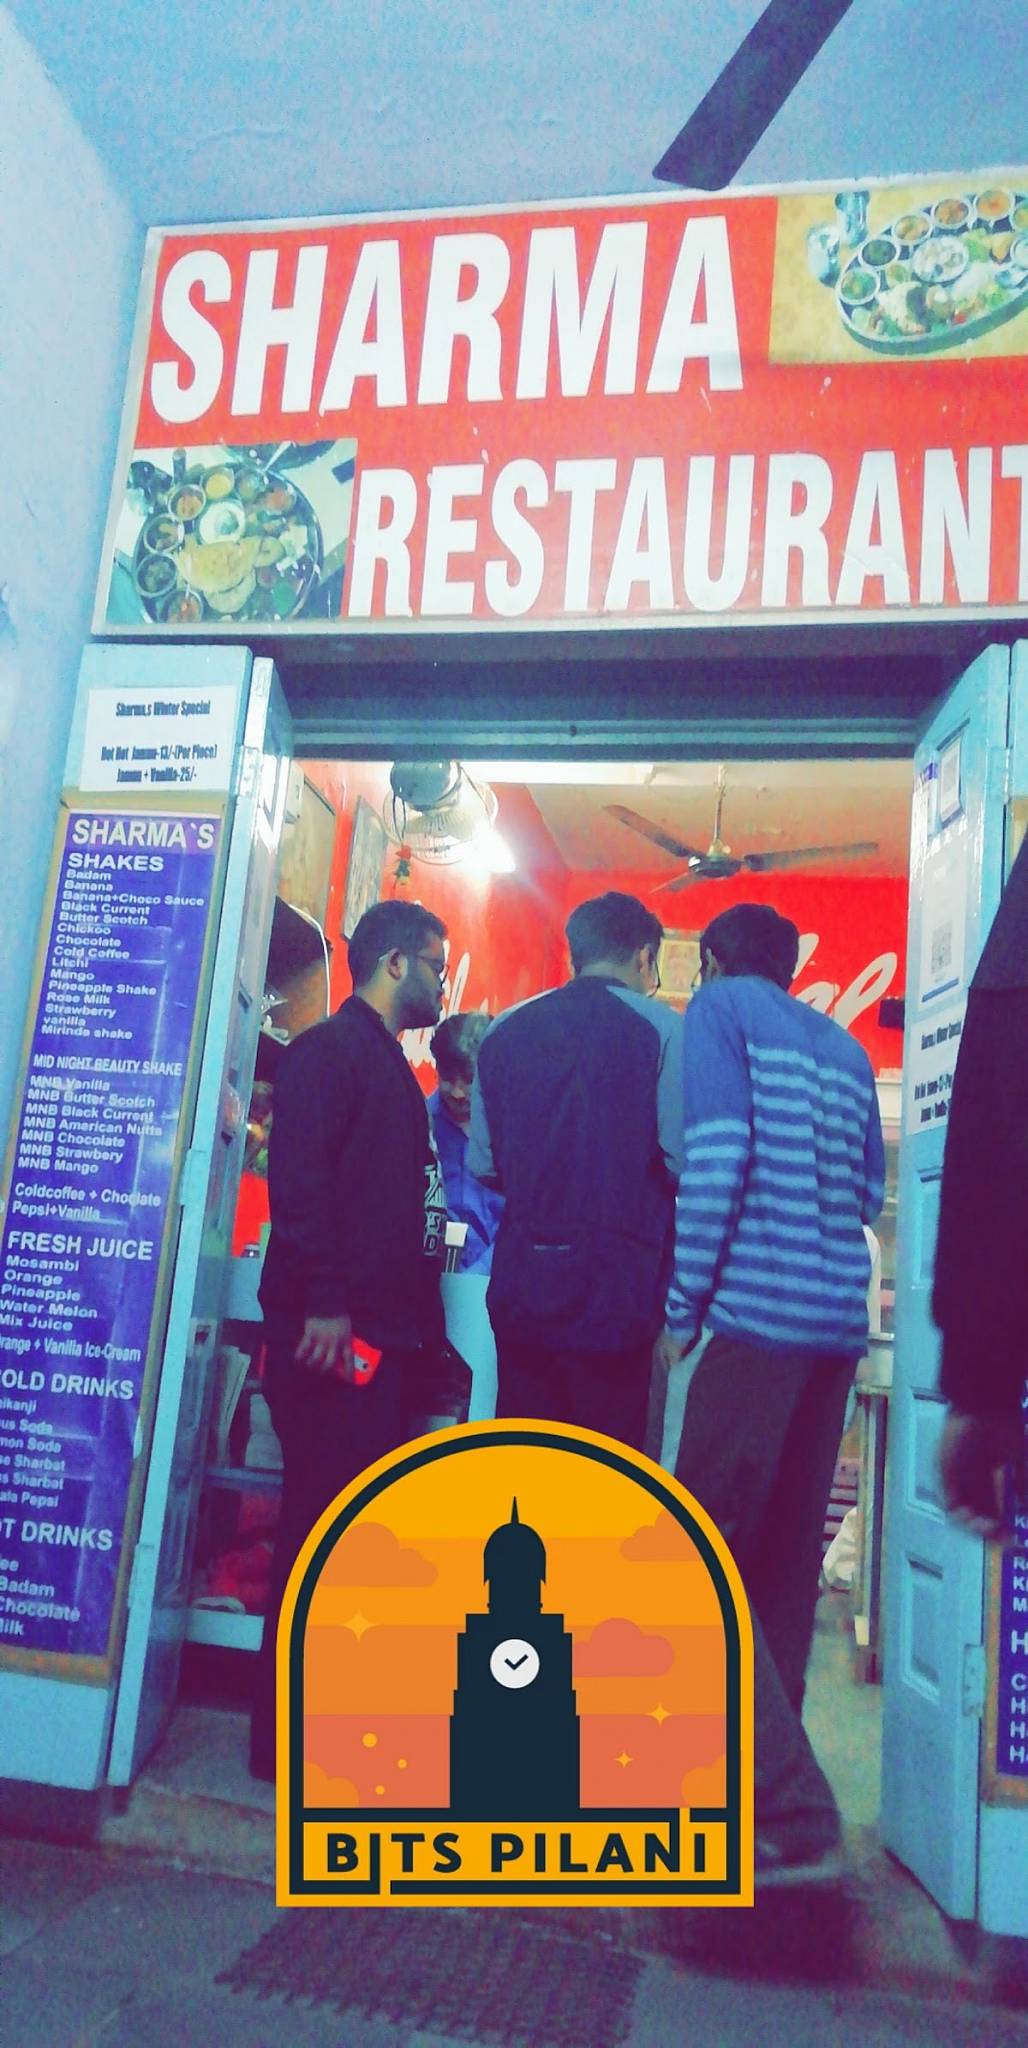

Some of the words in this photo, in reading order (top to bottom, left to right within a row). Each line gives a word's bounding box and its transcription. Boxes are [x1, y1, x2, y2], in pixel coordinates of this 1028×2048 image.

[150, 214, 744, 424] SHARMA
[153, 701, 180, 716] Winter
[181, 699, 211, 718] Special
[67, 852, 165, 872] SHAKES
[66, 868, 112, 881] Badam
[64, 879, 114, 892] Banana
[61, 901, 97, 913] Black
[101, 903, 150, 915] Current
[164, 894, 204, 907] Sauce
[59, 911, 99, 923] Butter
[103, 913, 148, 926] Scotch
[57, 922, 111, 935] Chickoo
[55, 933, 121, 948] Chocolate
[54, 945, 85, 958] Cold
[88, 947, 130, 960] Coffee
[52, 956, 88, 969] Litchi
[50, 968, 95, 982] Mango
[48, 979, 113, 994] Pineapple
[116, 983, 157, 996] Shake
[46, 991, 80, 1002] Rose
[83, 993, 110, 1005] Milk
[45, 1003, 117, 1019] Strawberry
[41, 1024, 91, 1037] Mirinda
[94, 1026, 133, 1040] shake
[33, 1054, 55, 1068] MID
[57, 1055, 91, 1071] NIGHT
[94, 1058, 140, 1073] BEAUTY
[142, 1061, 183, 1076] SHAKE
[30, 1075, 62, 1089] MNB
[65, 1077, 110, 1091] Vanilla
[28, 1088, 60, 1101] MNB
[63, 1090, 105, 1105] Butter
[108, 1093, 155, 1108] Scotch
[25, 1102, 58, 1115] MNB
[61, 1104, 99, 1119] Black
[102, 1108, 154, 1123] Current
[23, 1116, 56, 1129] MNB
[59, 1118, 123, 1134] American
[21, 1129, 54, 1143] MNB
[57, 1131, 126, 1147] Chocolate
[19, 1143, 52, 1156] MNB
[55, 1145, 124, 1164] Strawbery
[17, 1156, 50, 1170] MNB
[54, 1159, 99, 1175] Mango
[15, 1182, 86, 1201] Coldcoffee
[7, 1230, 82, 1255] FRESH
[86, 1237, 154, 1261] JUICE
[6, 1254, 80, 1272] Mosambi
[4, 1269, 64, 1287] Orange
[1, 1283, 81, 1302] Pineapple
[0, 1300, 44, 1314] Water
[48, 1302, 98, 1319] Melon
[0, 1313, 23, 1327] Mix
[27, 1316, 73, 1331] Juice
[0, 1335, 31, 1355] range
[44, 1336, 83, 1357] Vanilla
[84, 1340, 141, 1362] Ice-Cream
[0, 1368, 45, 1391] OLD
[50, 1372, 134, 1400] DRINKS
[19, 1418, 53, 1435] Soda
[27, 1437, 62, 1453] Soda
[14, 1453, 66, 1472] Sharbat
[12, 1472, 64, 1490] Sharbat
[21, 1491, 59, 1509] Pepsi
[0, 1518, 16, 1539] T
[21, 1519, 113, 1551] DRINKS
[0, 1575, 55, 1597] Badam
[0, 1617, 24, 1636] ilk
